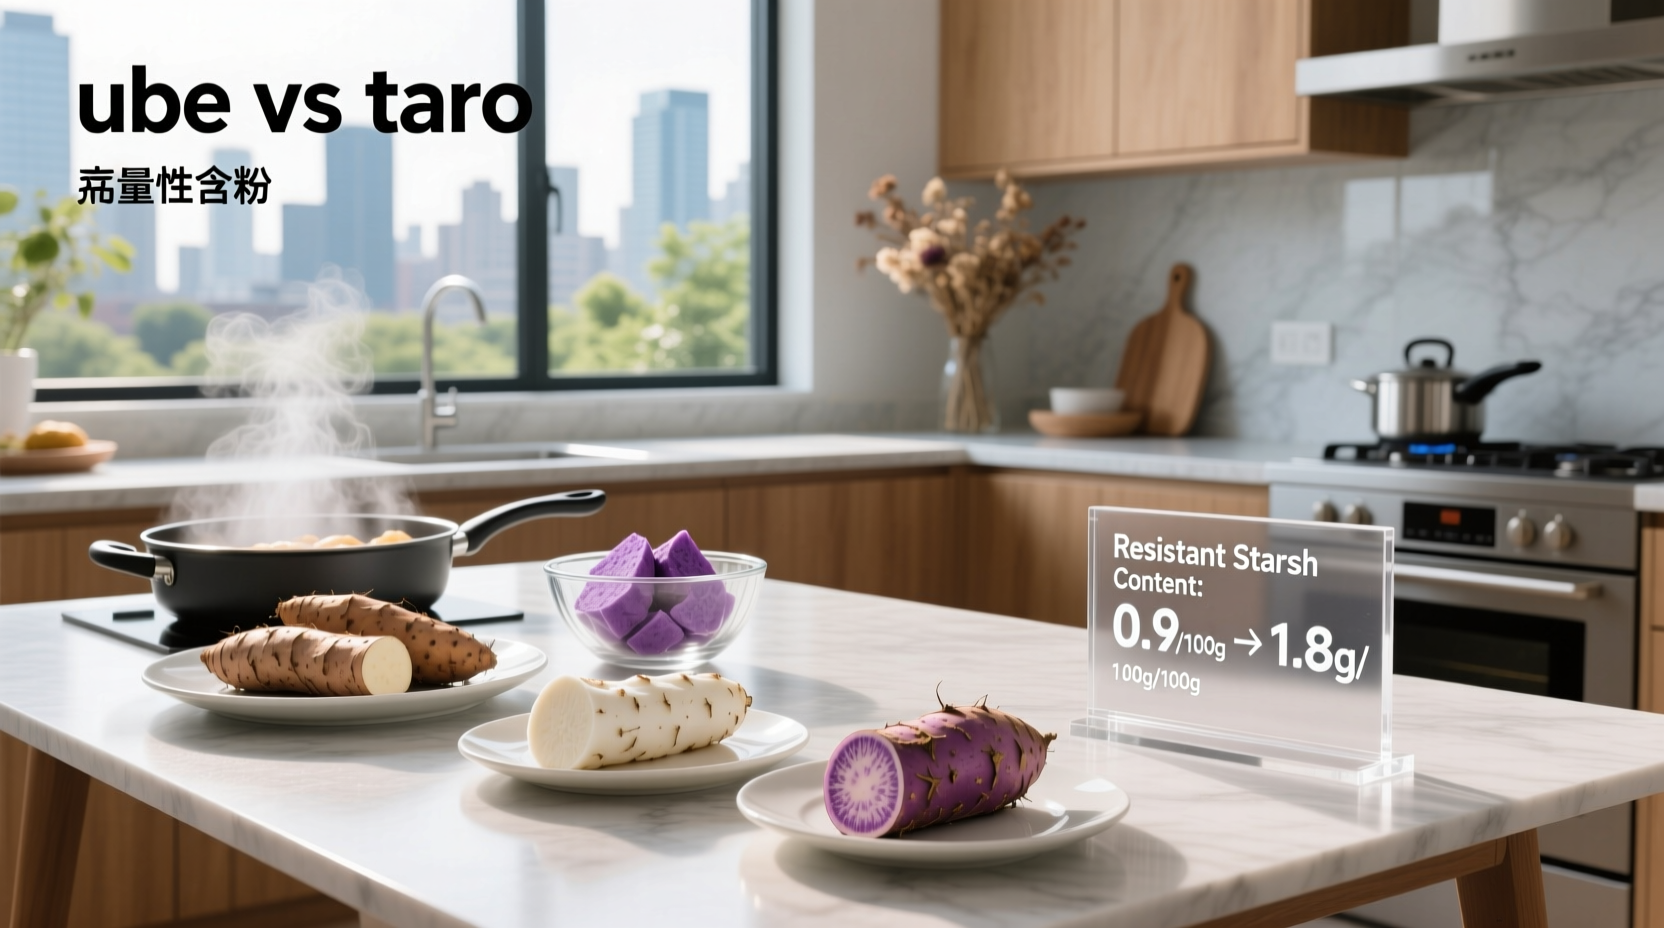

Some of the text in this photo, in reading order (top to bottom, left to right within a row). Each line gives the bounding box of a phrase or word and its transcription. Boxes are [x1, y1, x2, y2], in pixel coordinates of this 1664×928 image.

[1113, 532, 1318, 577] Resistant Starsh
[1113, 566, 1203, 597] Content:
[1112, 602, 1370, 684] 0.9/100g 1.8g/
[1112, 662, 1201, 697] 100g/100g
